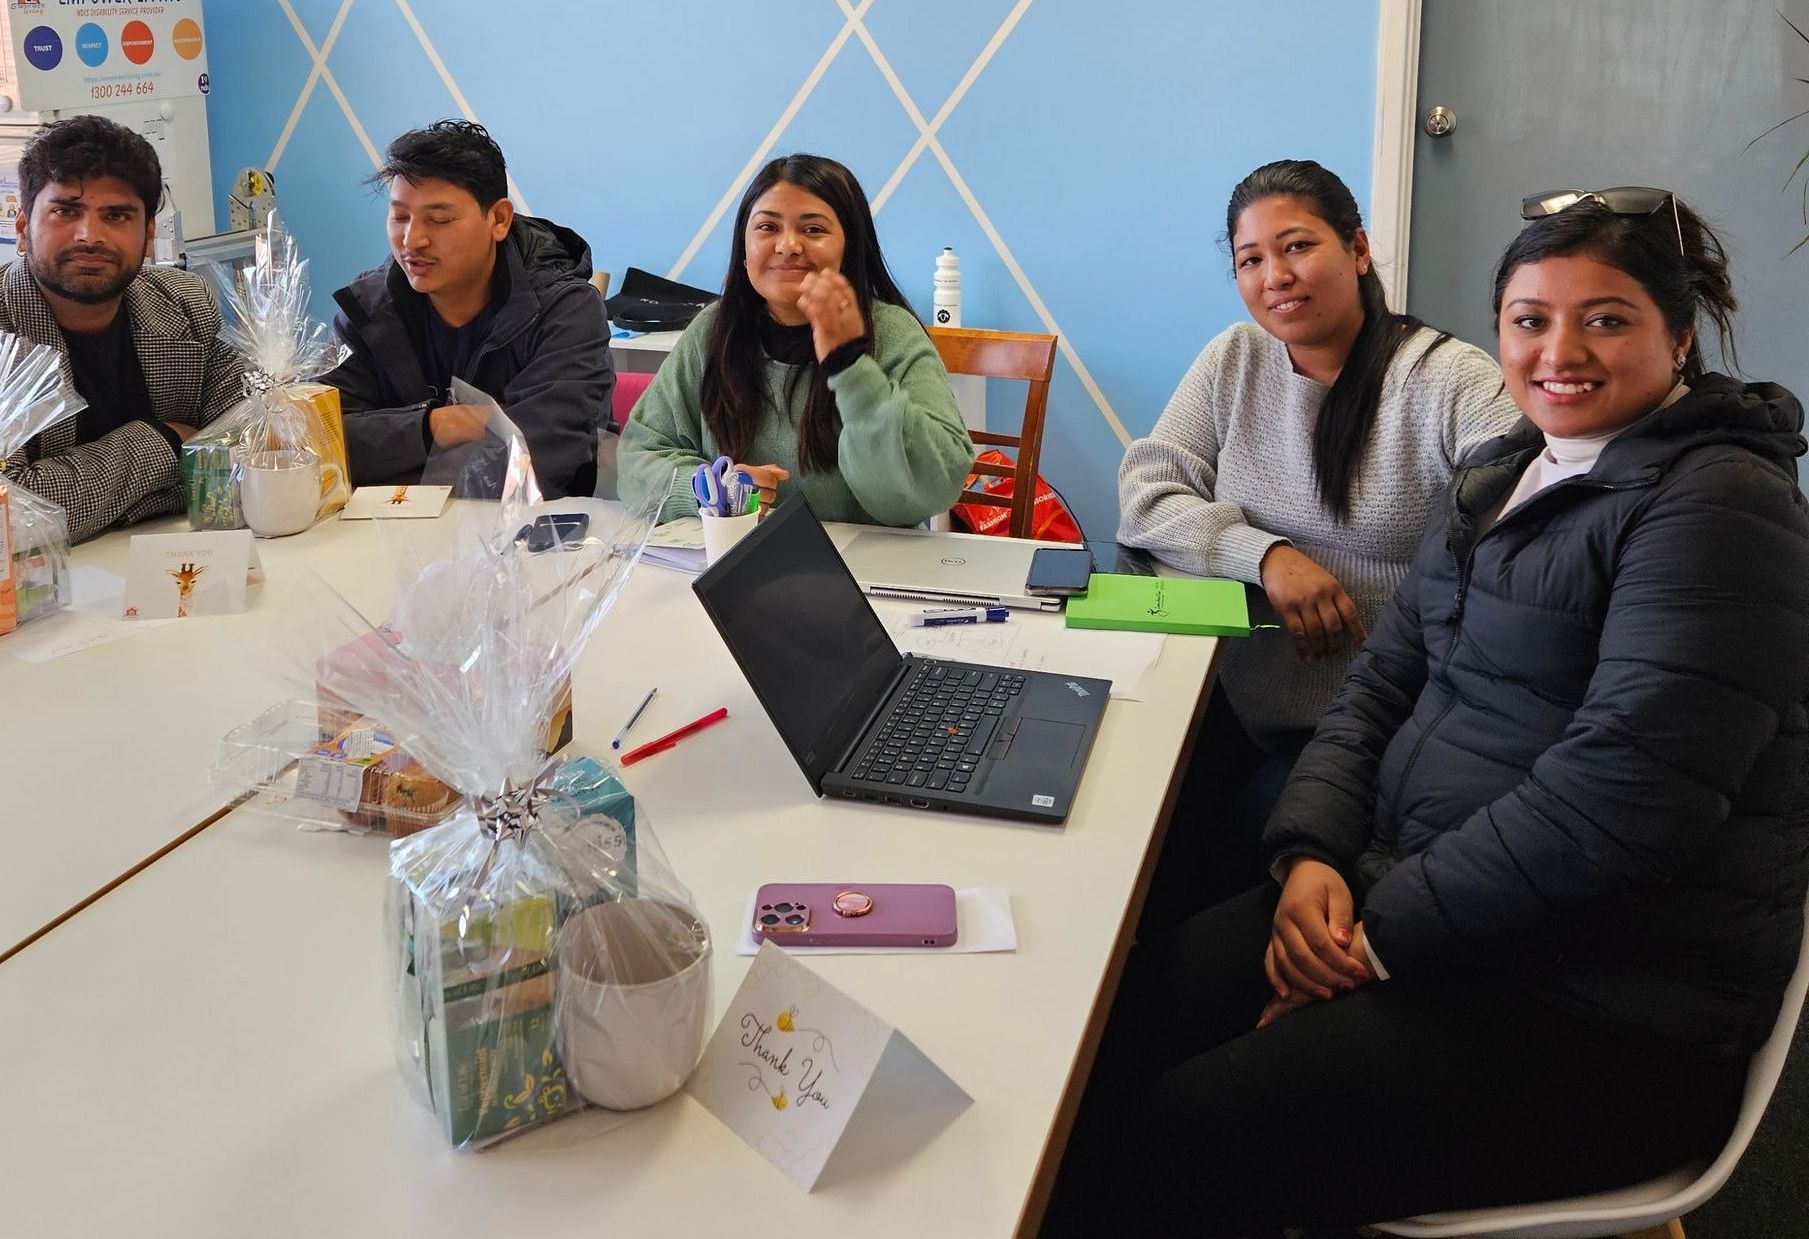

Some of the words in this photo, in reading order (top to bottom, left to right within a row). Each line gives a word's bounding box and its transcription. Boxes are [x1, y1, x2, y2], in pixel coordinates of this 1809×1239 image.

[90, 8, 118, 16] DISABILITY
[119, 7, 138, 15] SERVICE
[139, 6, 165, 14] PROVIDER
[91, 84, 113, 99] 1300
[115, 83, 133, 97] 244
[136, 81, 154, 95] 664
[979, 511, 1008, 531] FASHION
[165, 550, 194, 559] THANK
[196, 549, 214, 557] YOU
[740, 1012, 793, 1076] Thank
[796, 1058, 830, 1109] You
